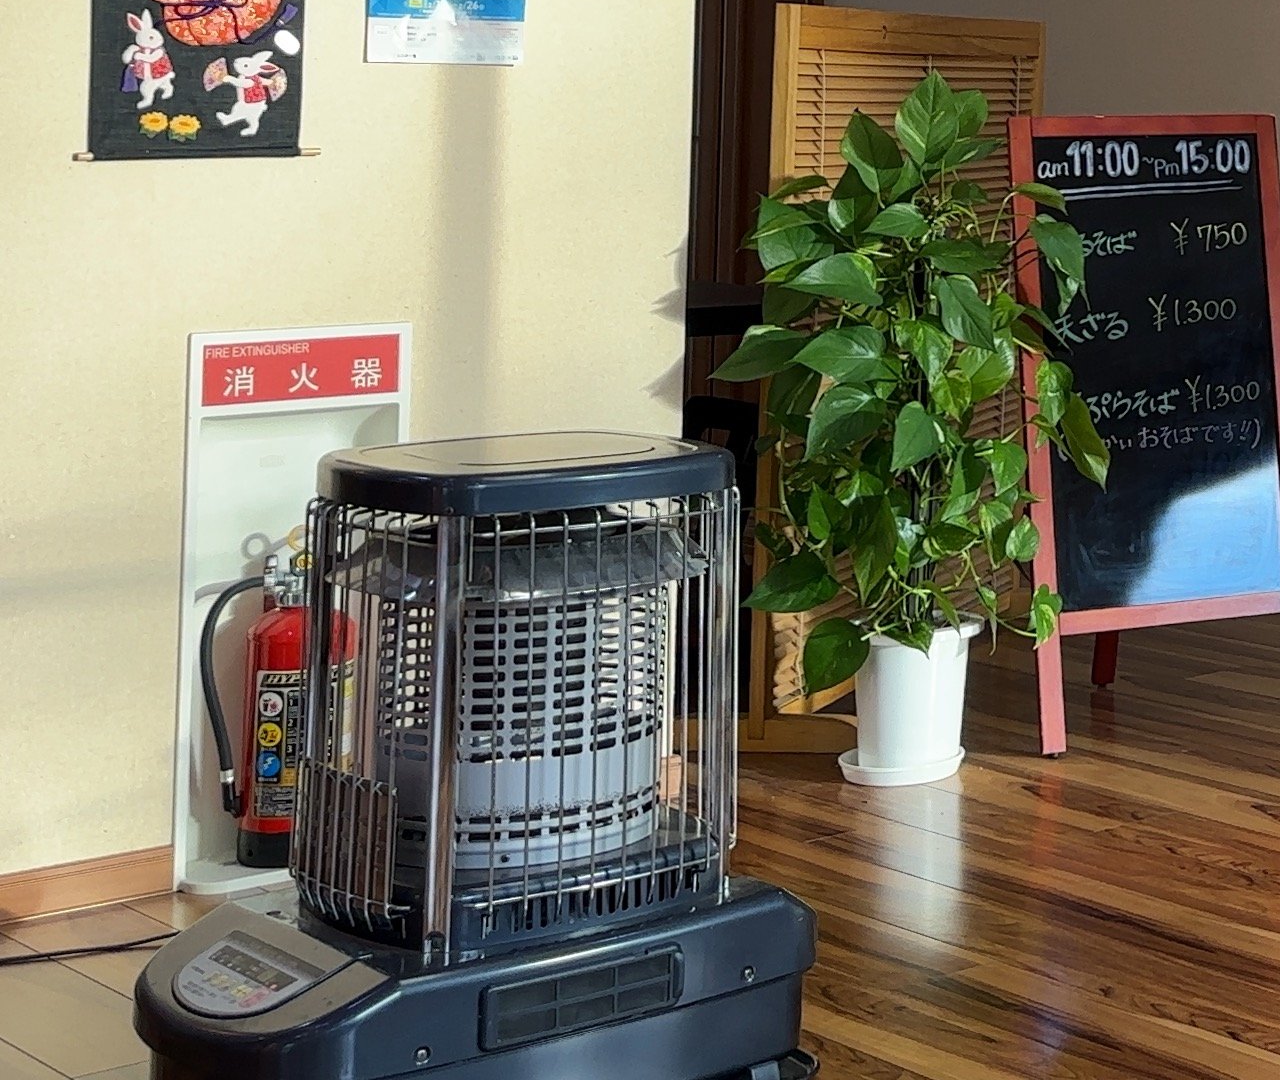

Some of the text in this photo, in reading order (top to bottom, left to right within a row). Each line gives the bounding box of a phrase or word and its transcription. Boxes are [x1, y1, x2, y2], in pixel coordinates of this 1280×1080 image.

[205, 341, 311, 360] FIRE EXTINGUISHER
[223, 357, 383, 397] 消火器
[1080, 388, 1180, 424] ぷらそば
